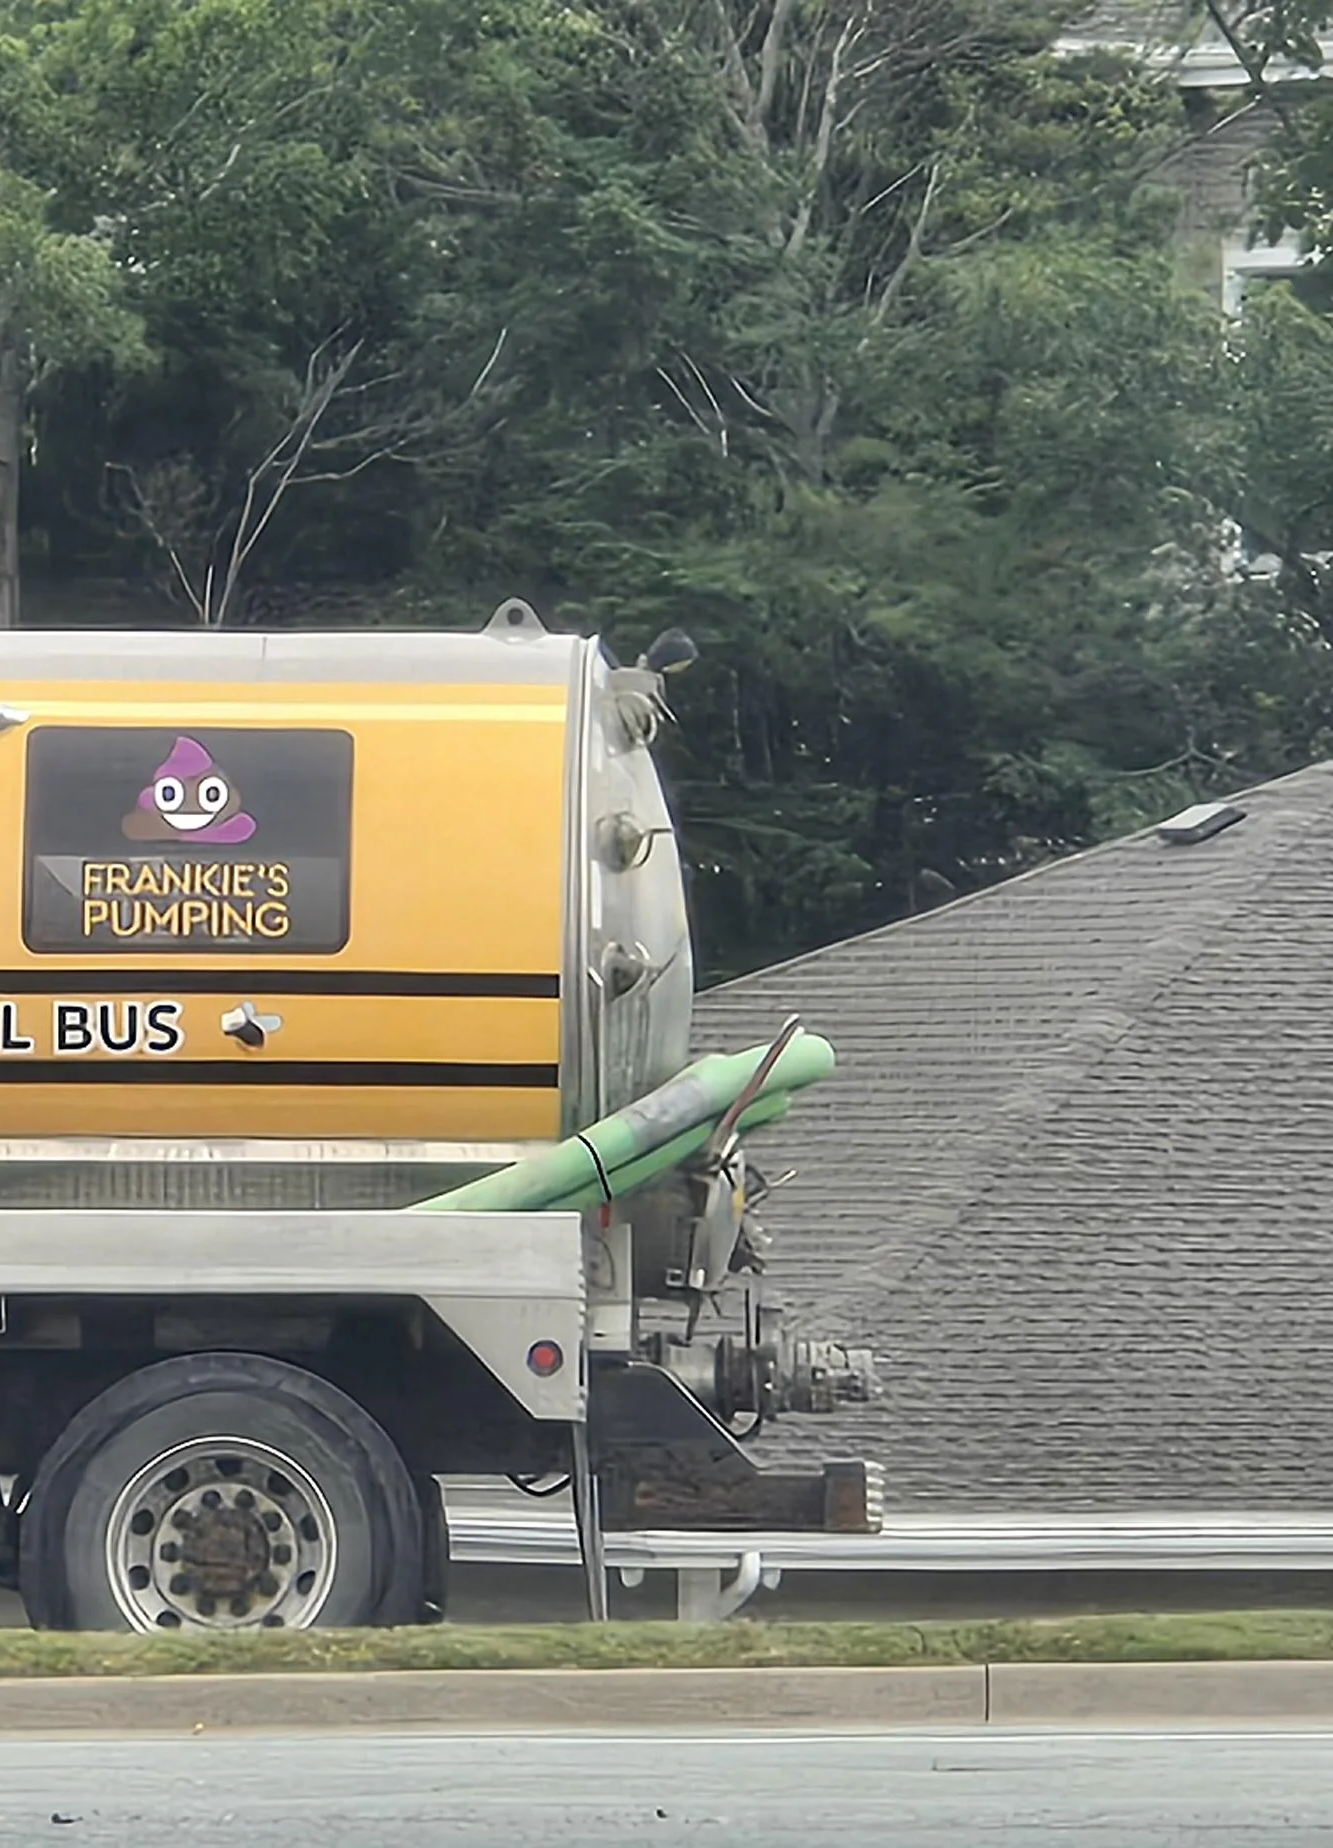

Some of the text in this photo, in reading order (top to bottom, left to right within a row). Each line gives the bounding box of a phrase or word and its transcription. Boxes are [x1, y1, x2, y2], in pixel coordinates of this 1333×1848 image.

[84, 862, 289, 897] FRANKIE'S
[84, 899, 289, 937] PUMPING
[56, 1003, 180, 1052] BUS
